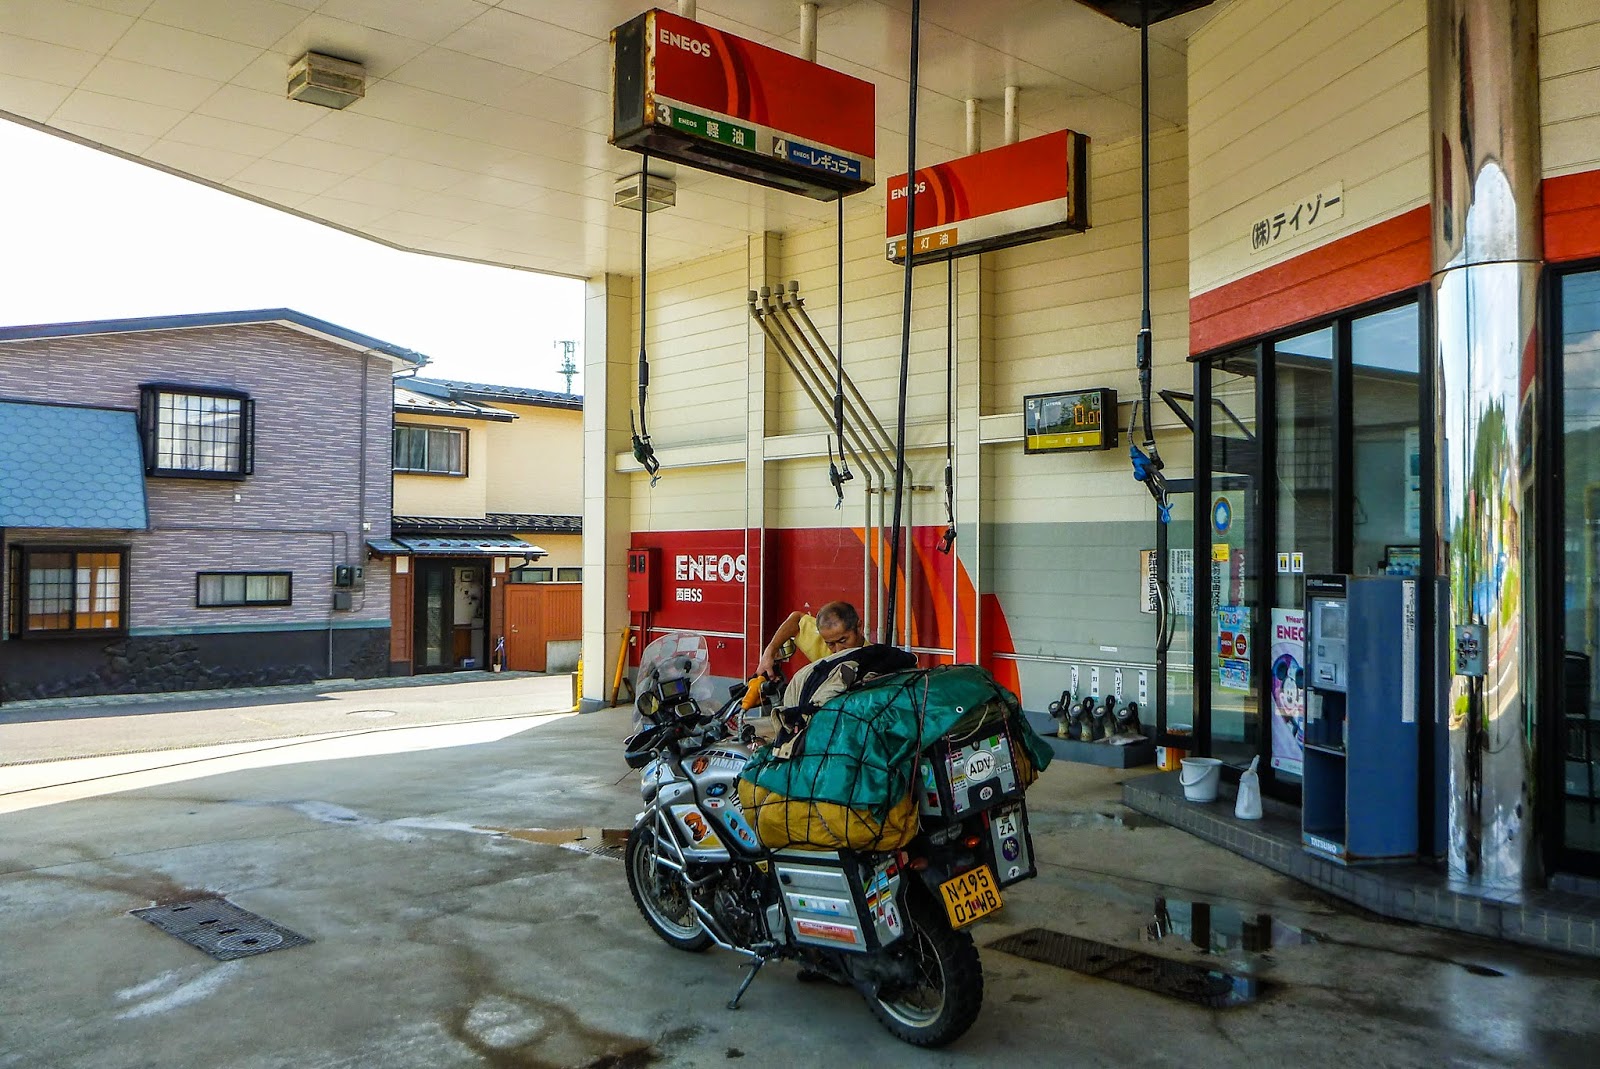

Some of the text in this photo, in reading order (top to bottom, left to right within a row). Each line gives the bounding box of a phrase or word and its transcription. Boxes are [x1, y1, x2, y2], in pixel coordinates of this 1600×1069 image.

[660, 28, 711, 57] ENEOS
[657, 105, 744, 146] 3 ENEOS 軽油
[774, 139, 857, 173] 4 ENEOS レギュラー
[888, 242, 897, 259] 5
[920, 233, 949, 250] 灯油
[1028, 400, 1035, 410] 5
[675, 554, 746, 582] ENEOS
[969, 756, 991, 776] ADV
[999, 822, 1015, 836] ZA
